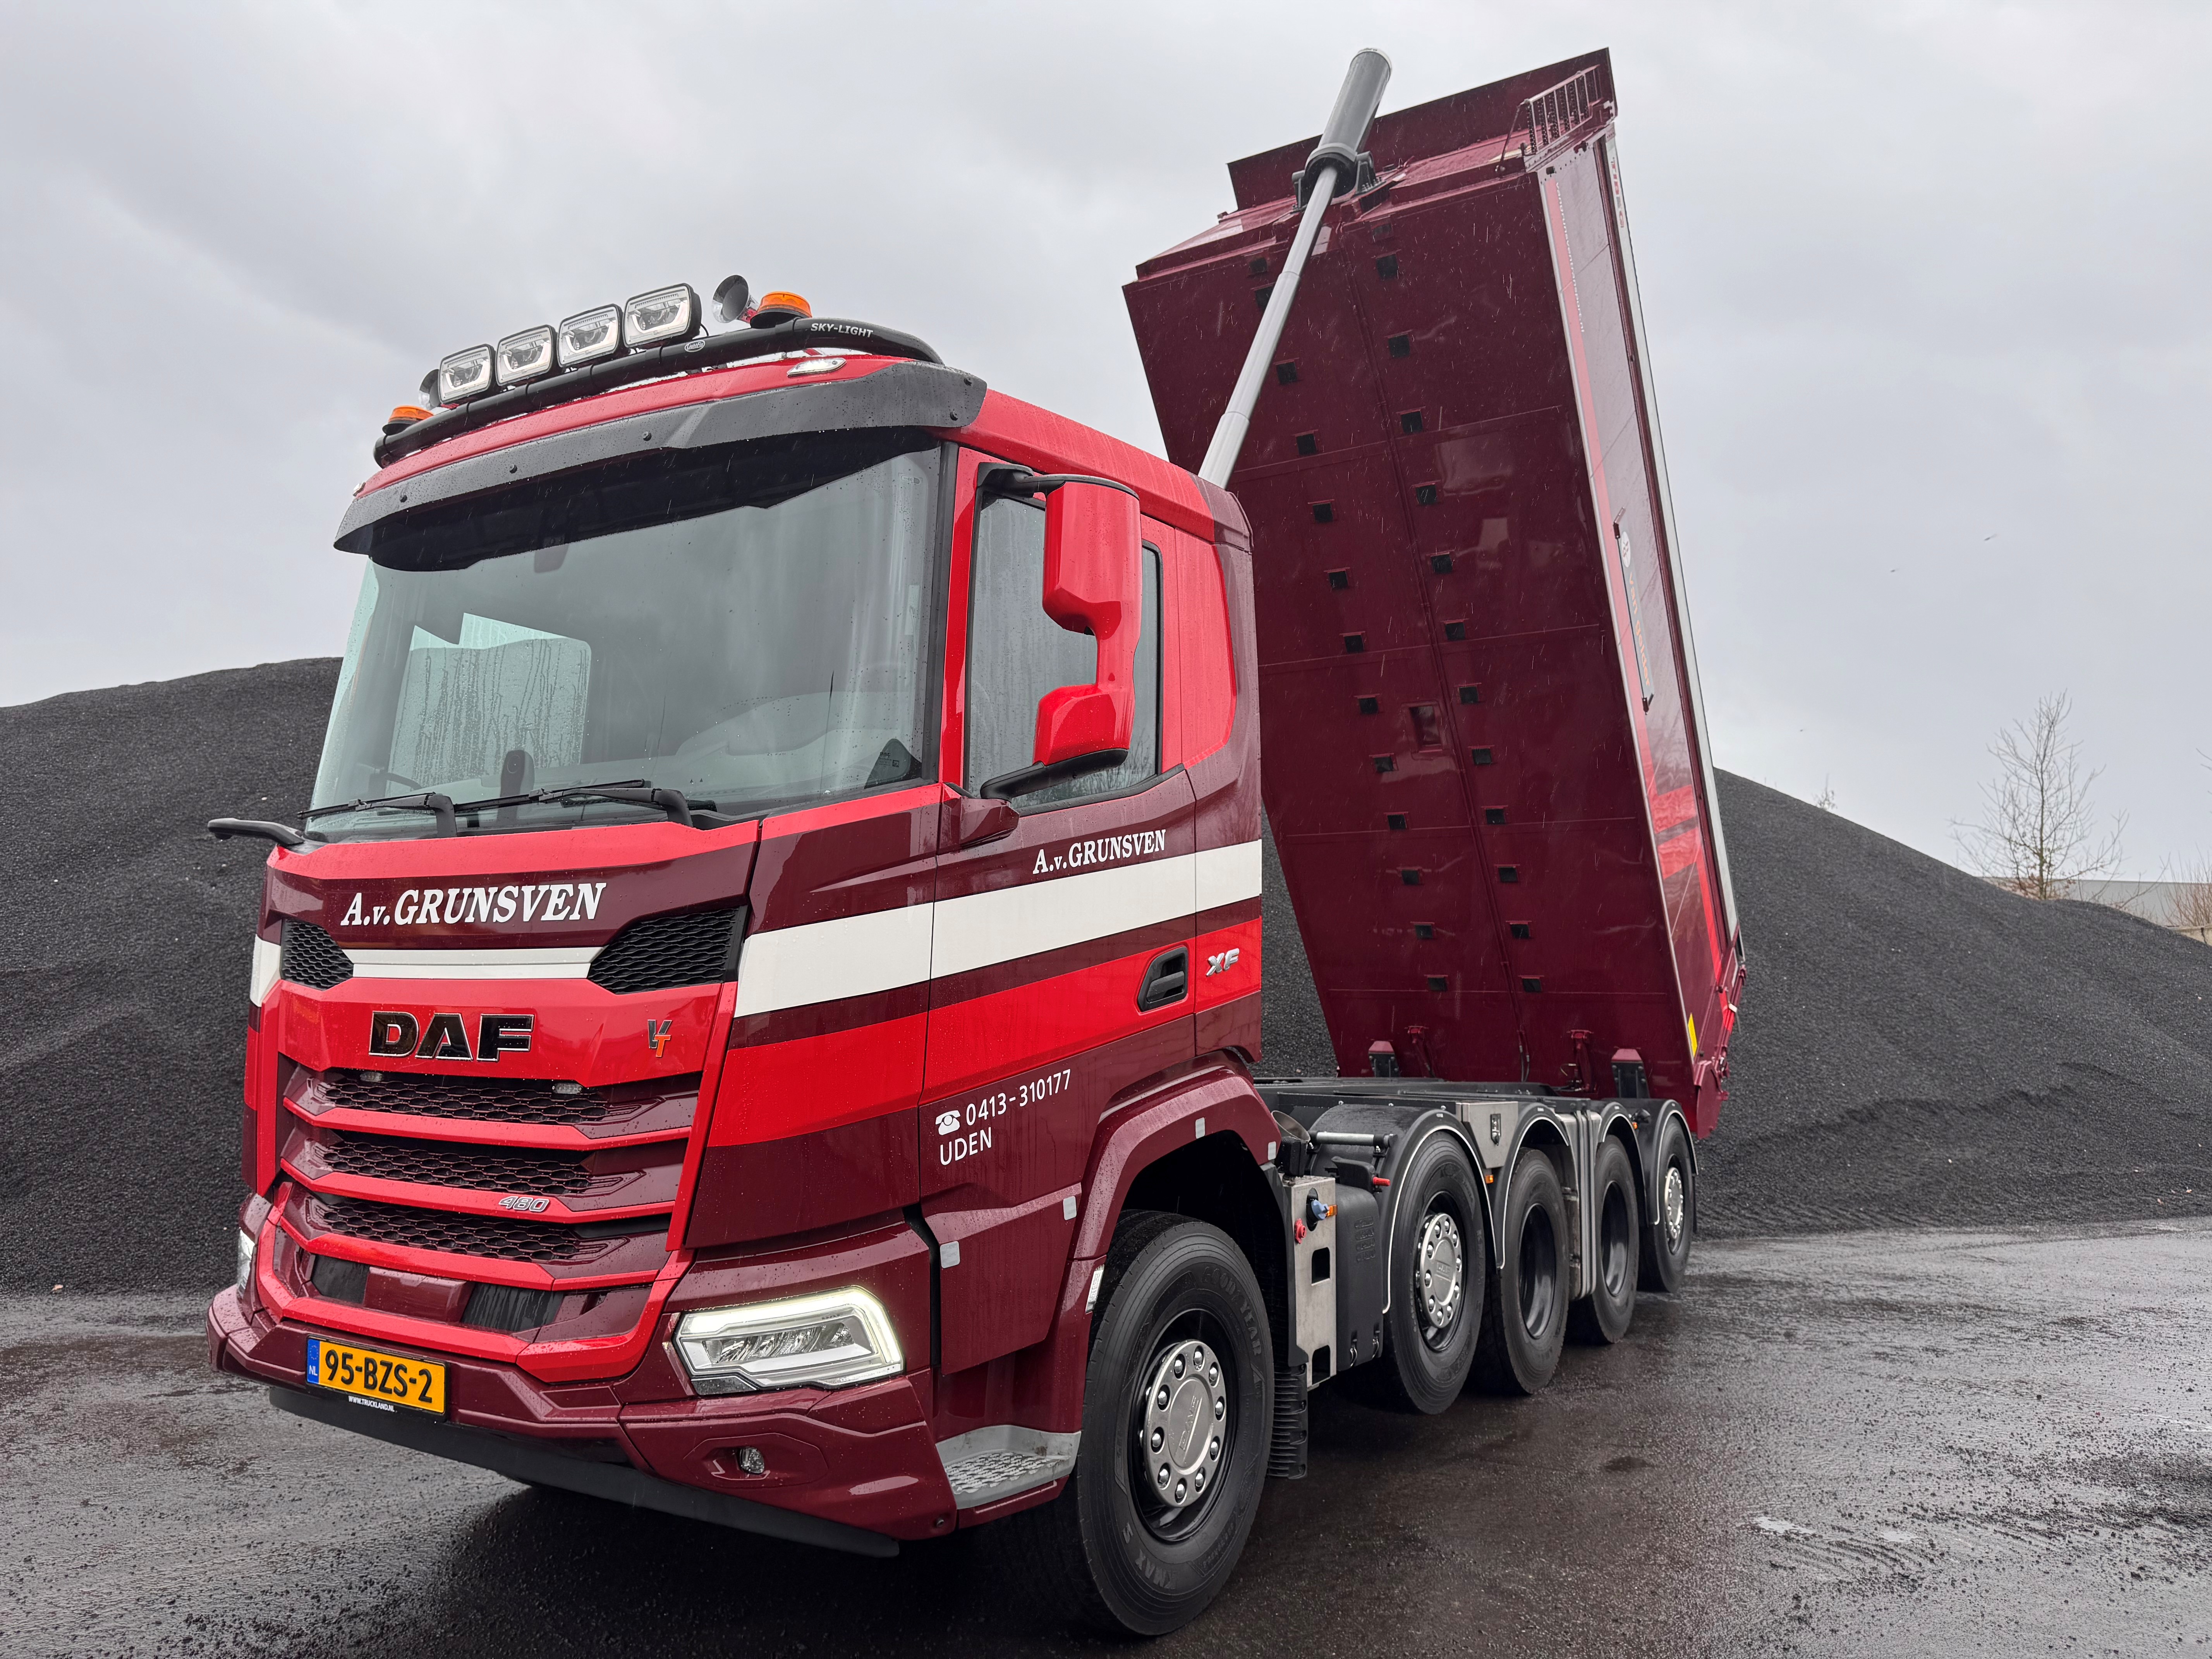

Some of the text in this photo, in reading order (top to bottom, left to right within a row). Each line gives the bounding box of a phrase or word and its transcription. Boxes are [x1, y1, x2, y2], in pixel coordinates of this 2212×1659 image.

[811, 323, 873, 338] SKY-LIGHT
[1629, 572, 1638, 614] van
[1032, 830, 1166, 874] A.v.GRUNSVEN
[341, 882, 607, 926] A.v.GRUNSVEN
[1206, 948, 1240, 977] XF
[368, 1010, 534, 1062] DAF
[966, 1068, 1071, 1126] 0413-310177
[939, 1127, 991, 1166] UDEN
[498, 1195, 549, 1213] 480
[309, 1365, 318, 1376] NL
[325, 1349, 433, 1403] 95-BZS-2
[348, 1395, 395, 1412] WWW.TRUCKLAND.NL
